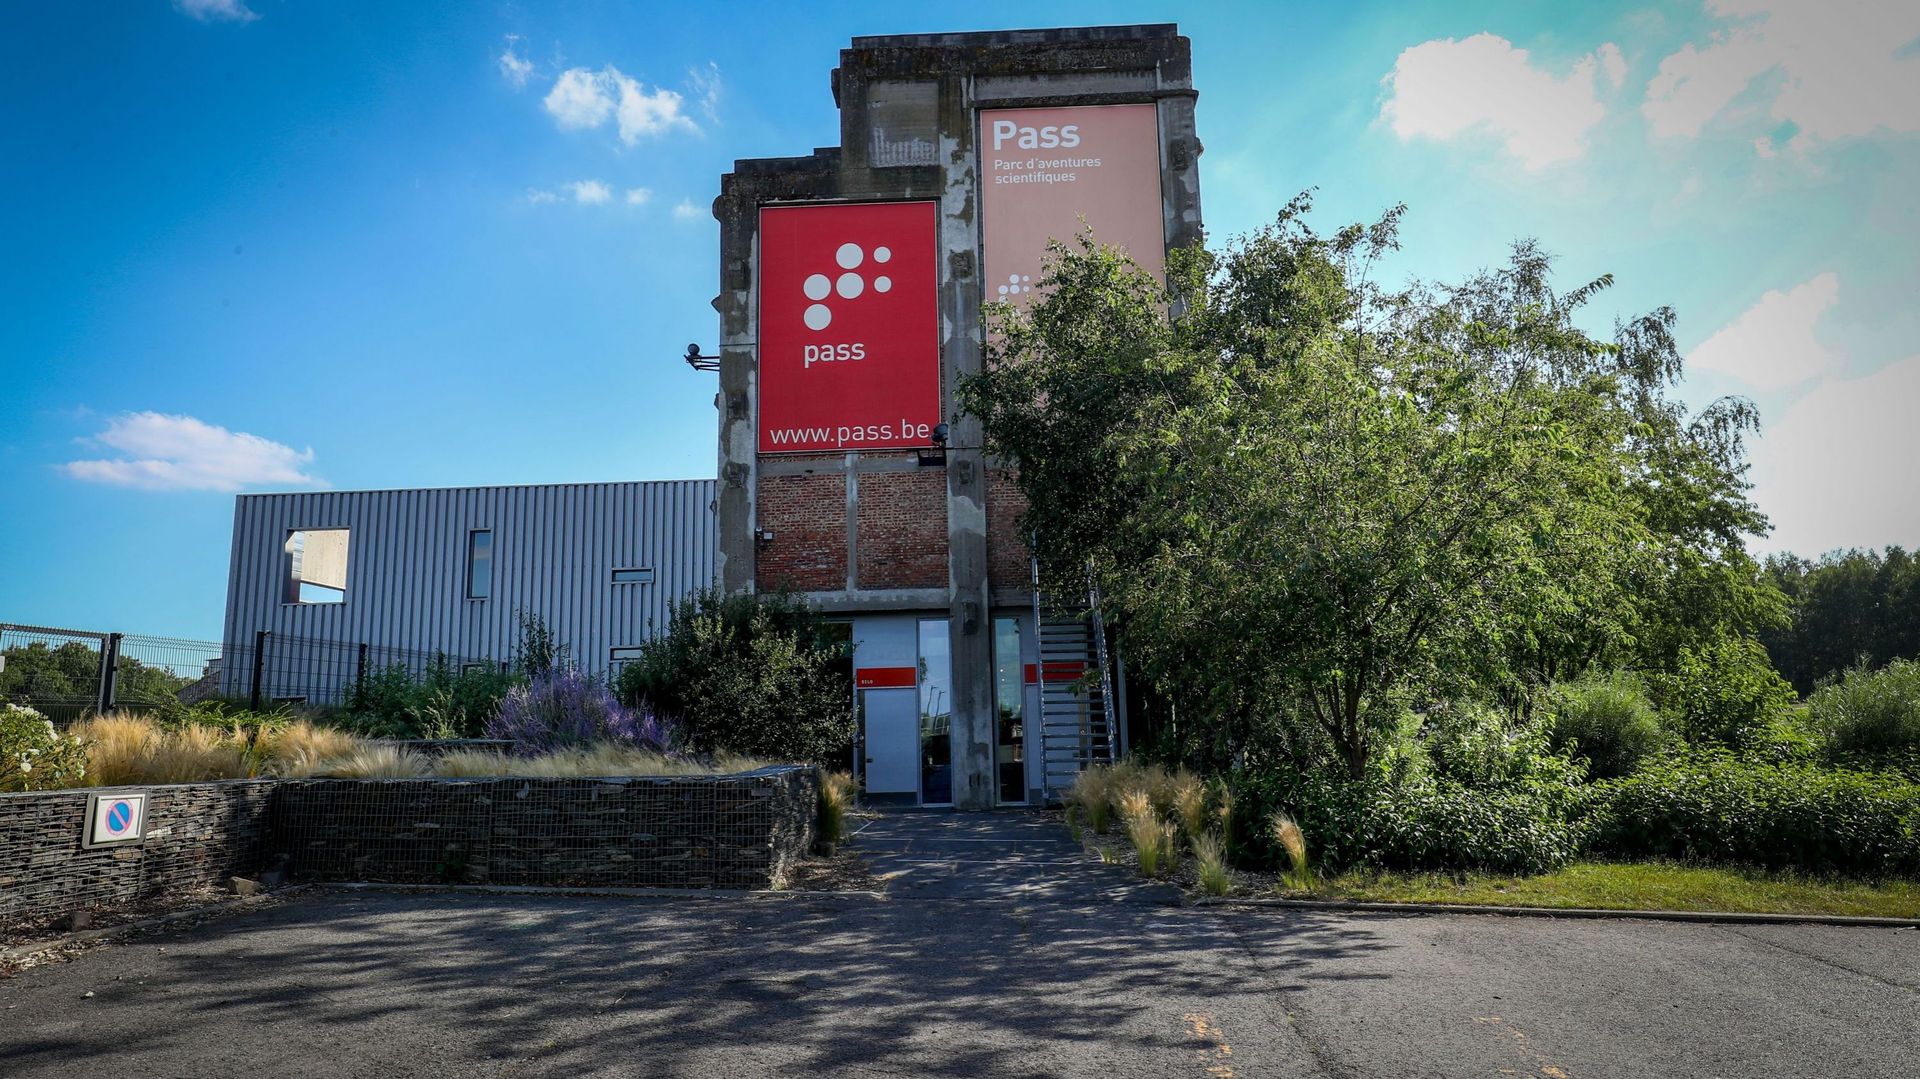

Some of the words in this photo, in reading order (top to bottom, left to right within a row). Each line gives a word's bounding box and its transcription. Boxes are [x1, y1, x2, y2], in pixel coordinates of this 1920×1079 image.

[993, 120, 1080, 150] Pass
[994, 159, 1022, 170] Parc
[1027, 157, 1101, 169] d'aventures
[995, 172, 1076, 184] scientifiques
[804, 342, 865, 368] pass
[770, 418, 929, 447] www.pass.be
